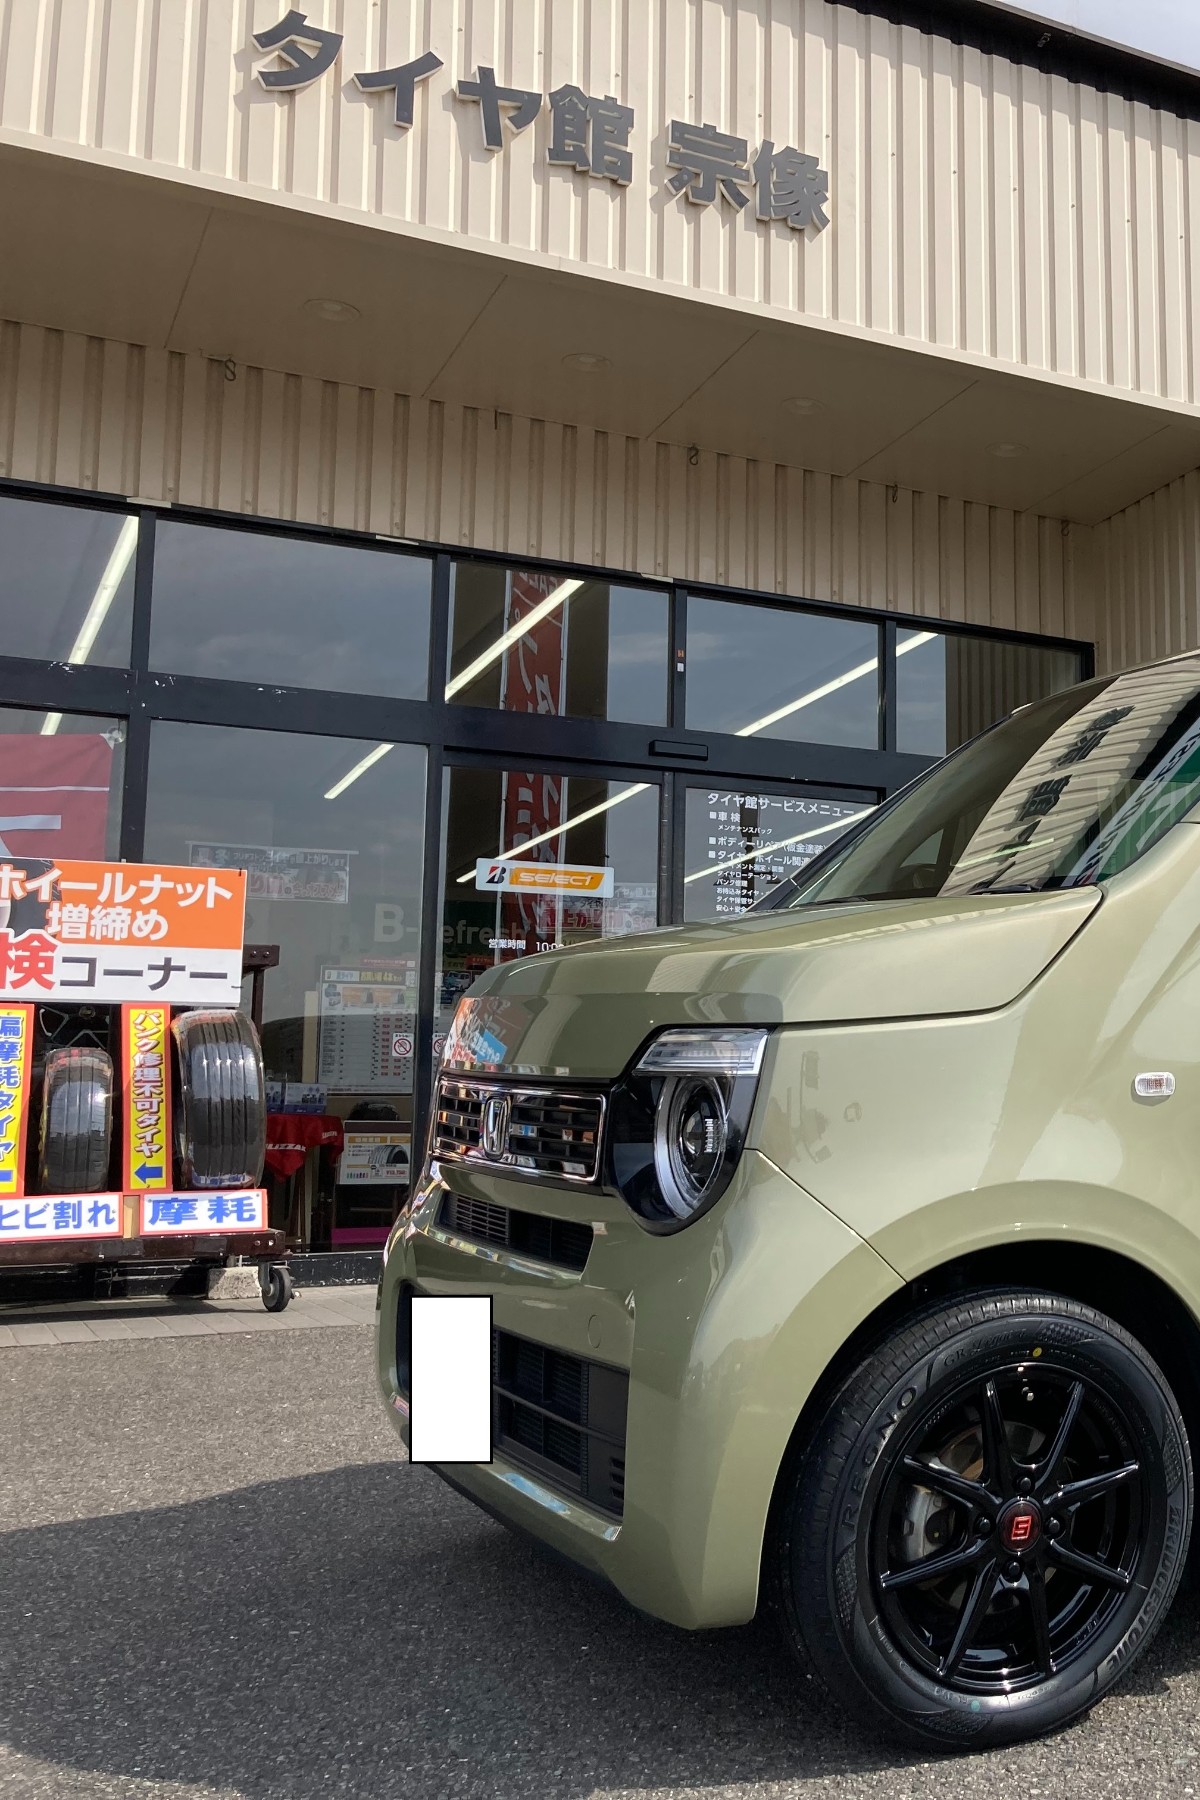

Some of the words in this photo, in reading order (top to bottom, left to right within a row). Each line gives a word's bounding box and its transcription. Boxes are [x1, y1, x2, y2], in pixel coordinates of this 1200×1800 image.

[252, 9, 636, 187] タイヤ館
[666, 118, 831, 232] 宗像
[707, 793, 854, 816] タイヤ館サービスメニュー
[0, 865, 233, 908] ホイールナット
[47, 903, 169, 942] 増締め
[488, 938, 526, 950] 営業時間
[132, 1012, 164, 1159] パンク修理不可タイヤ
[265, 1143, 306, 1152] LIZZAK
[0, 1198, 117, 1231] ヒビ割れ
[841, 1386, 918, 1532] REGNO
[1105, 1504, 1182, 1676] BRIDGESTONE
